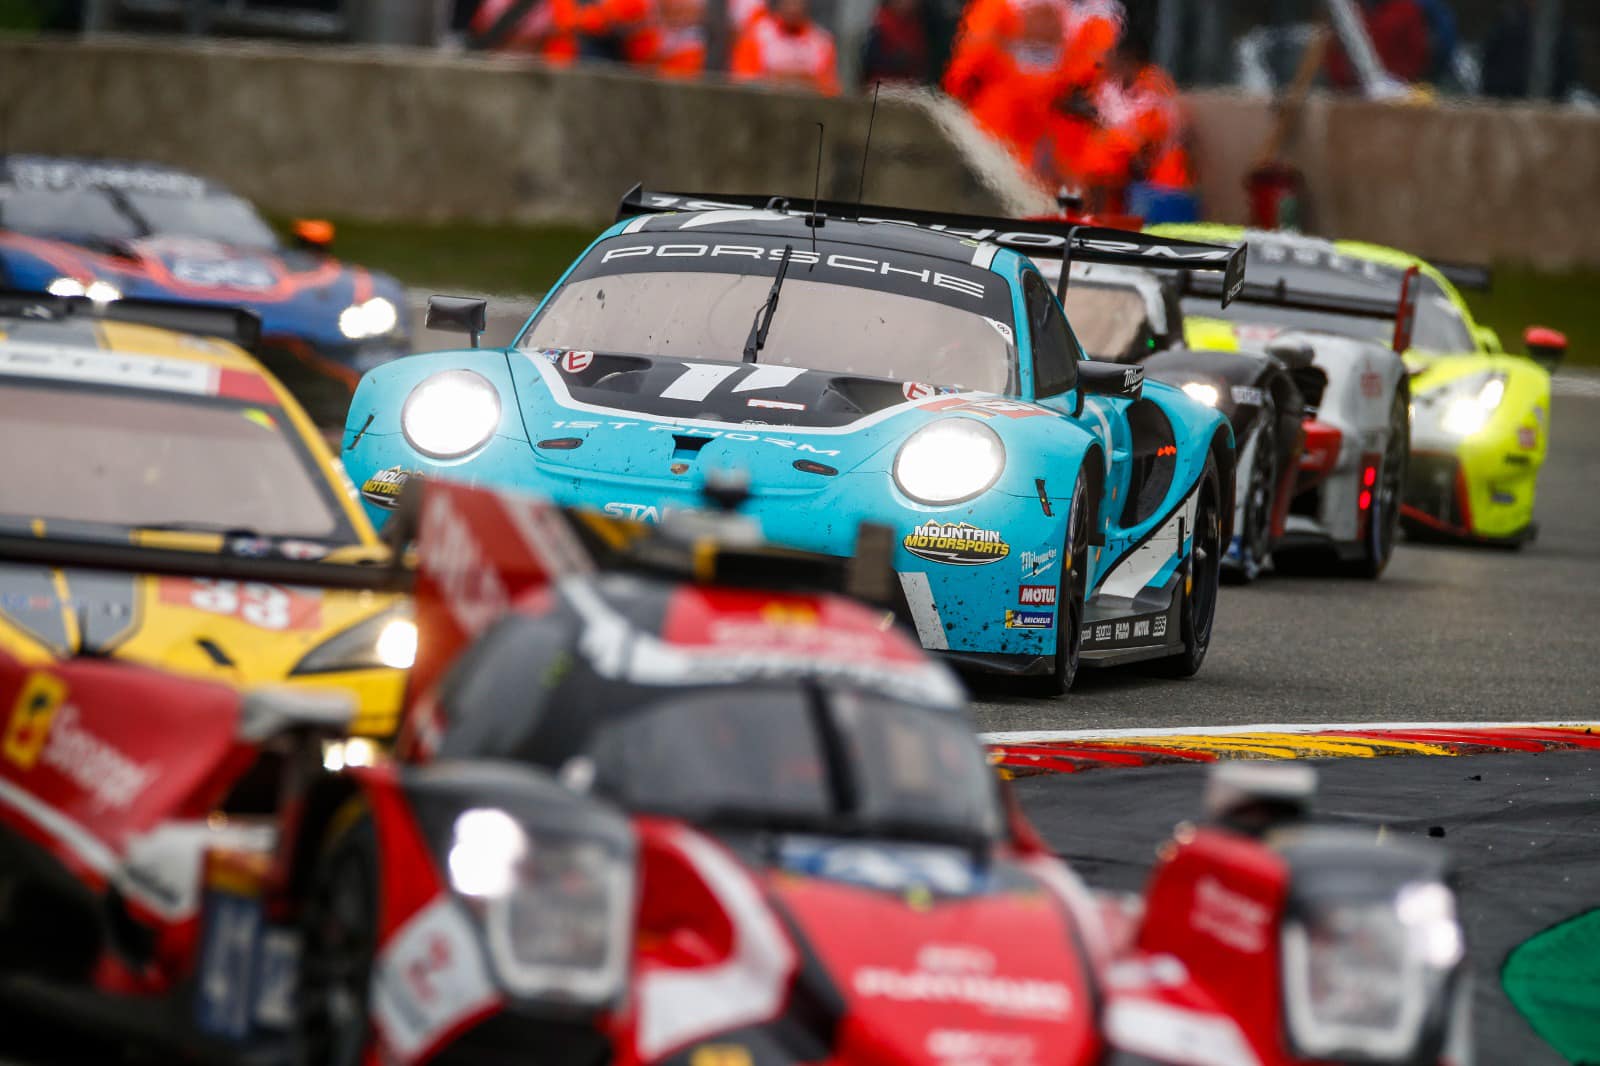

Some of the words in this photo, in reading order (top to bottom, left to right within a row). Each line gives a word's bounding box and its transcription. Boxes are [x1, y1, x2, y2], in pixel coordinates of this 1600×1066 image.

[601, 245, 984, 298] PORSCHE
[552, 420, 639, 429] 1ST
[648, 424, 841, 456] PHORM
[914, 526, 1000, 542] MOUNTAIN
[905, 535, 1010, 556] MOTORSPORTS
[1021, 587, 1056, 603] MOTUL
